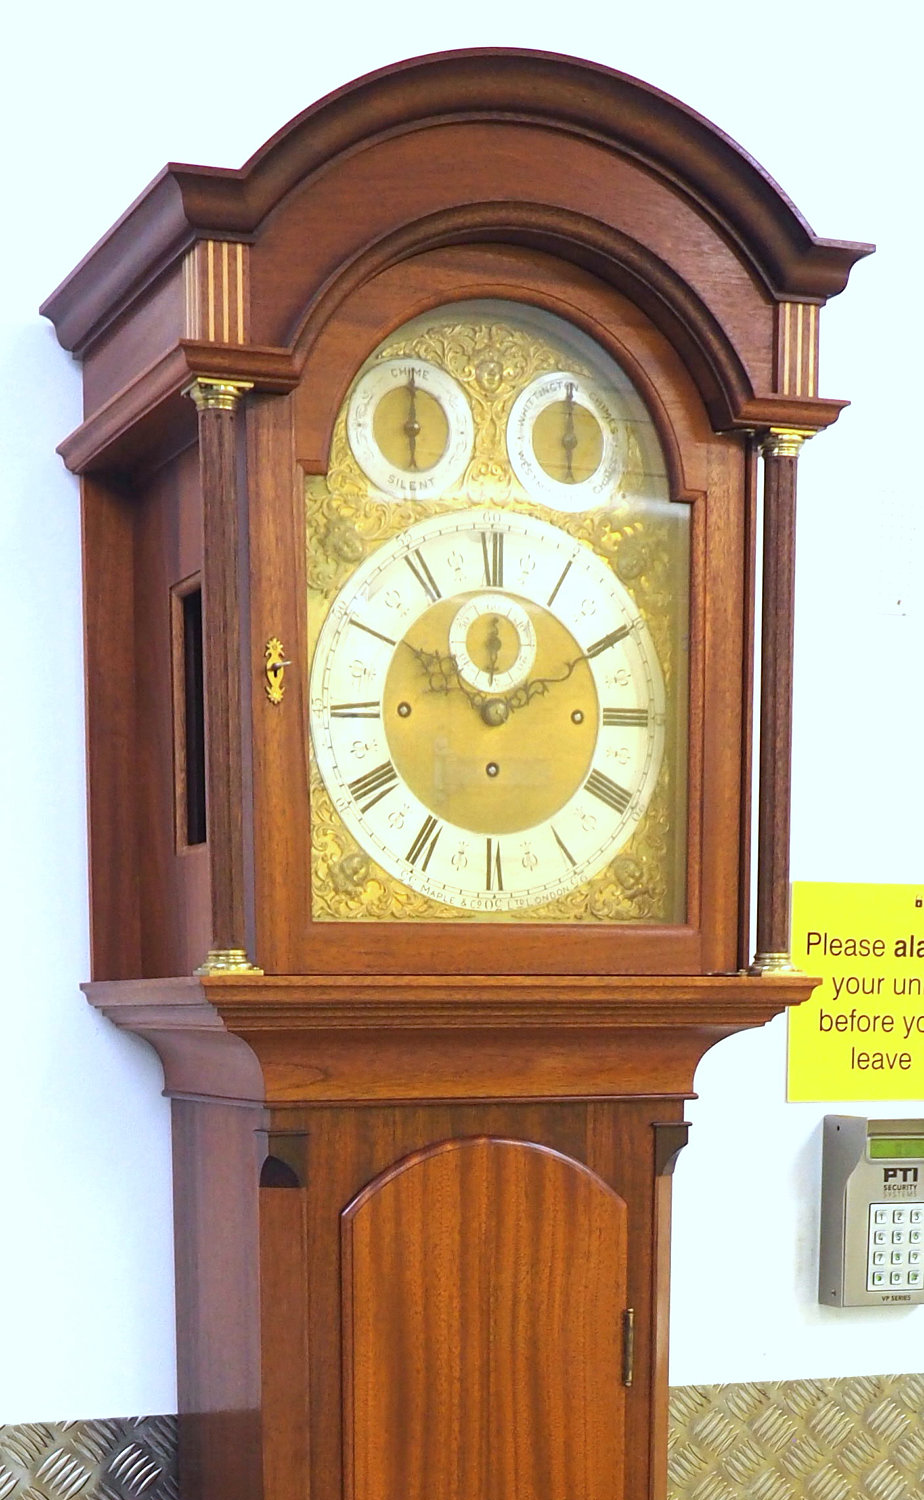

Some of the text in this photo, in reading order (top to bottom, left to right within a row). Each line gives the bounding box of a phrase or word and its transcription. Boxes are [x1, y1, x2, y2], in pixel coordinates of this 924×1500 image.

[390, 366, 430, 381] CHIME
[387, 474, 435, 491] SILENT
[482, 511, 502, 523] 60
[602, 706, 649, 729] III
[525, 886, 570, 908] LONDON
[806, 931, 886, 957] Please
[832, 976, 924, 1000] your un
[819, 1008, 895, 1033] before
[851, 1047, 912, 1070] leave
[883, 1167, 919, 1183] PTI
[891, 1294, 911, 1302] SERIES
